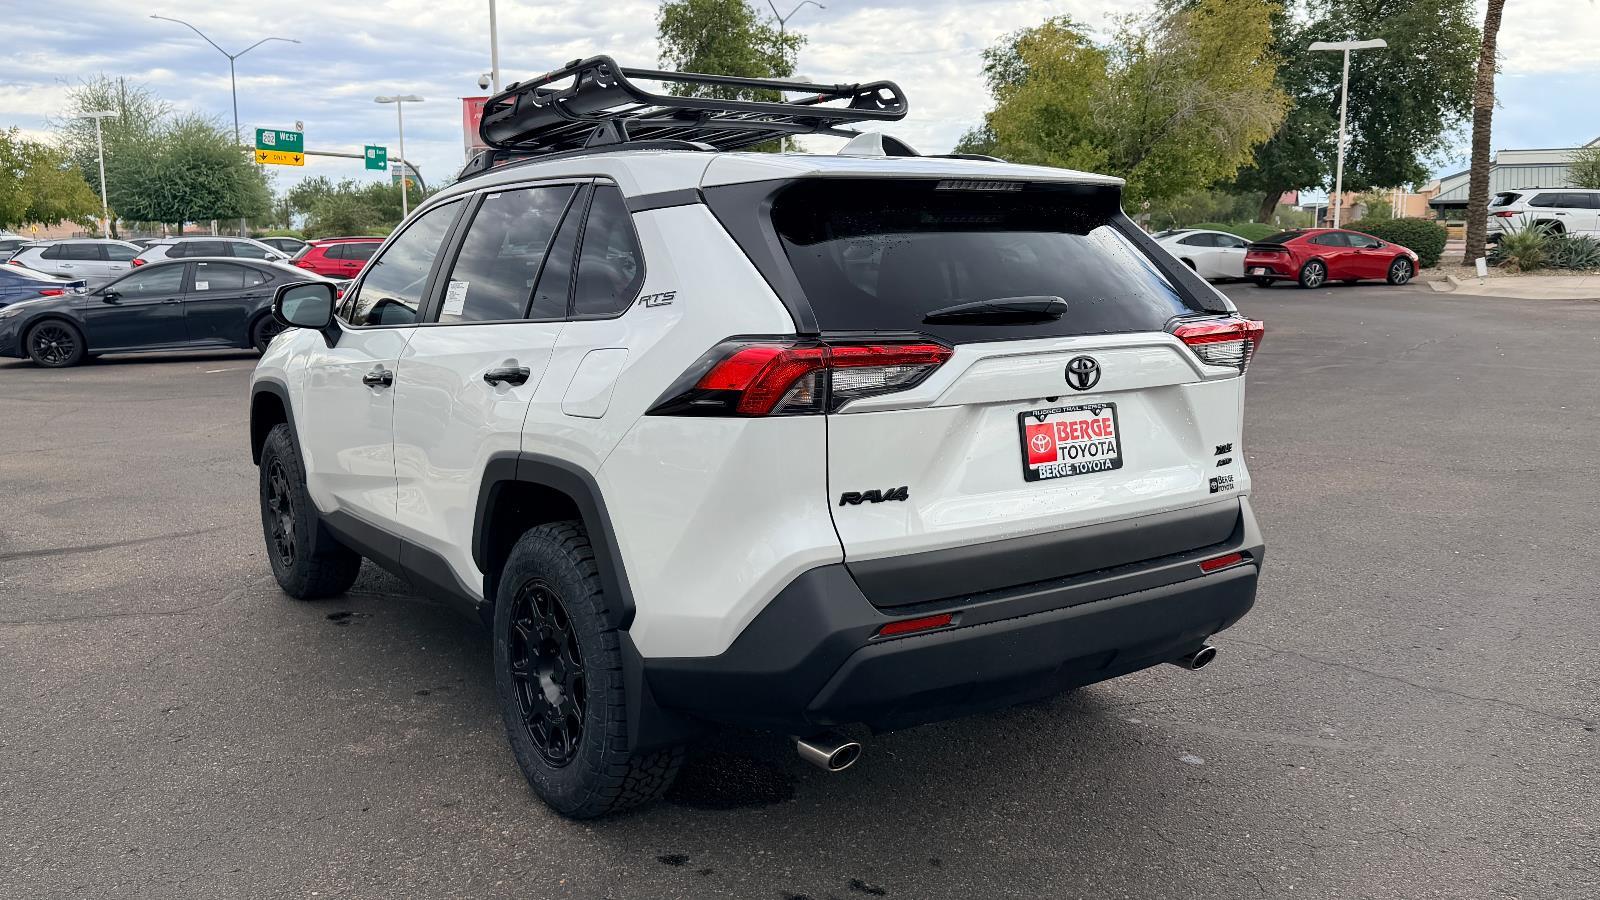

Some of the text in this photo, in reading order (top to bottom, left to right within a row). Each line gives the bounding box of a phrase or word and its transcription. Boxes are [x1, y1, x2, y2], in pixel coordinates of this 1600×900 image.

[263, 132, 297, 144] 202 WEST
[1056, 418, 1112, 442] BERGE
[1058, 440, 1116, 460] TOYOTA
[1039, 459, 1112, 478] BERGE TOYOTA
[839, 486, 909, 506] RAV4
